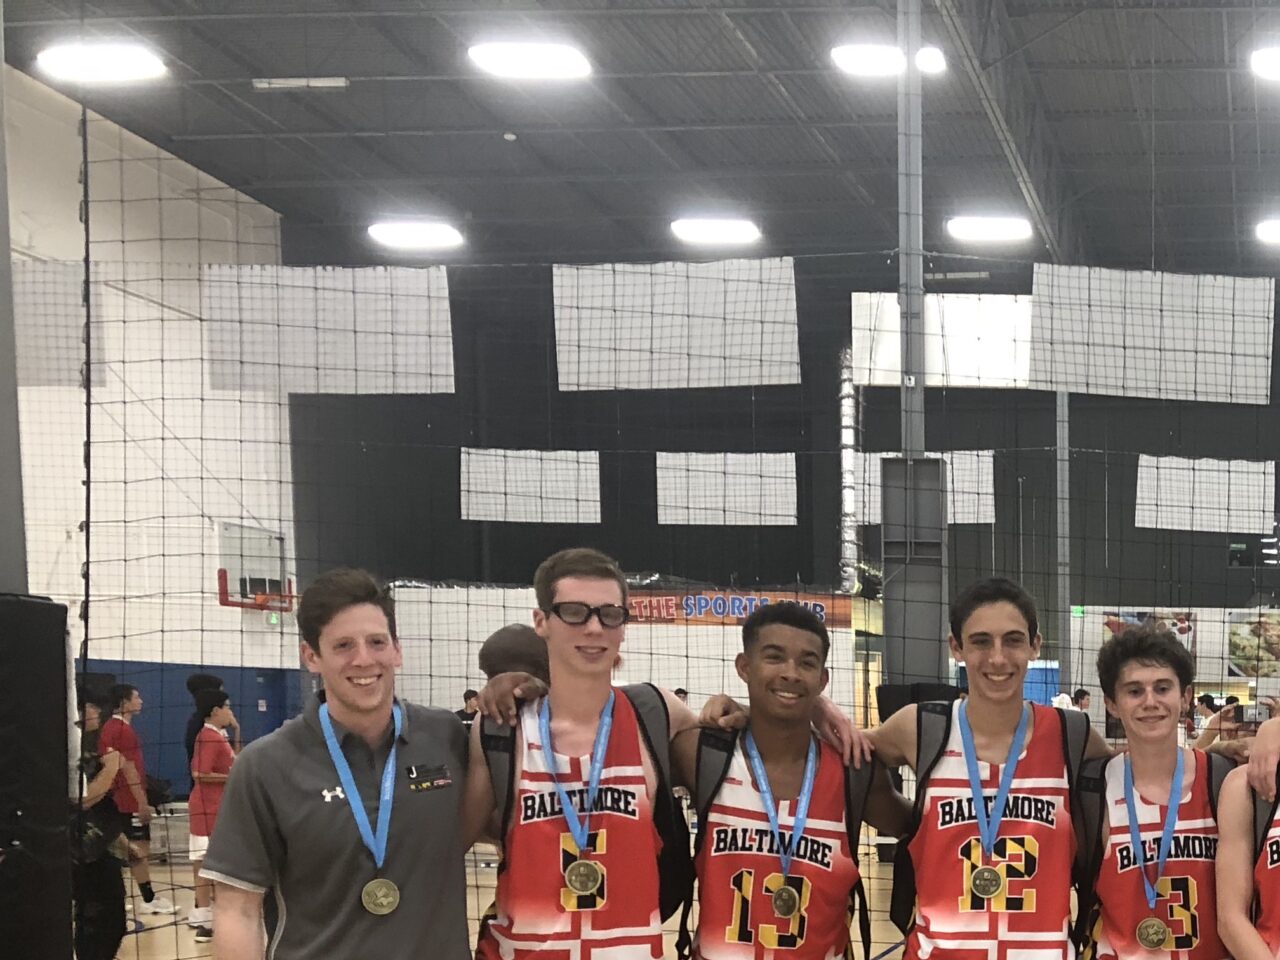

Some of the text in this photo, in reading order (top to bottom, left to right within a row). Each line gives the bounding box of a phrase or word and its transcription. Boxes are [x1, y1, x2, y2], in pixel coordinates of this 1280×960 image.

[632, 597, 676, 620] THE
[939, 795, 1057, 828] BALTMORE
[559, 829, 607, 911] 5
[958, 835, 1039, 913] 12
[725, 868, 812, 950] 13
[1153, 875, 1200, 951] 3
